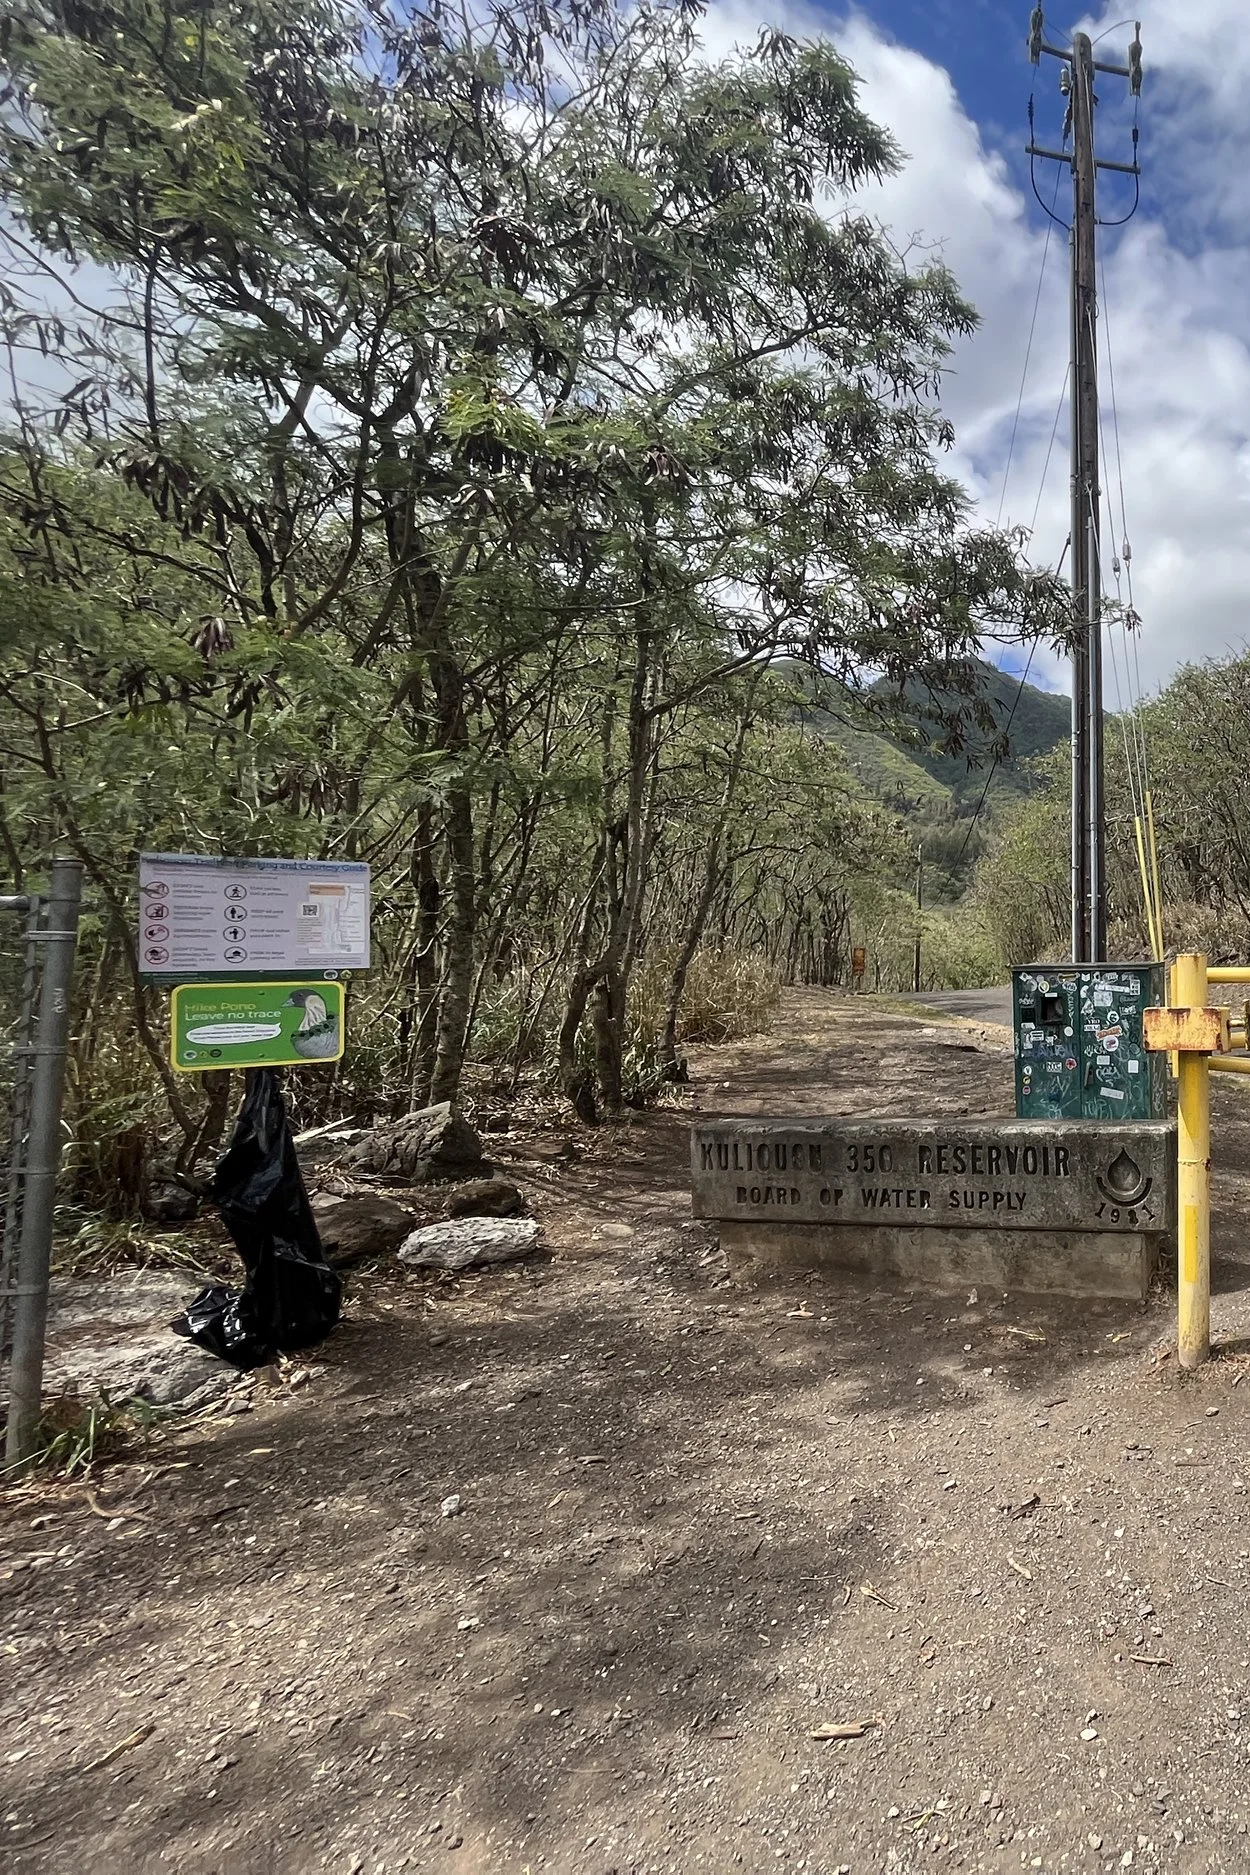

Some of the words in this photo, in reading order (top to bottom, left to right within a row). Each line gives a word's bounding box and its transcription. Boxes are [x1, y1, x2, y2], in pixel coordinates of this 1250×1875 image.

[278, 862, 297, 870] and
[299, 861, 341, 873] Courtesy
[342, 864, 368, 873] Guide
[184, 1004, 217, 1012] Hike
[220, 1002, 257, 1011] Pono
[185, 1012, 224, 1021] Leave
[248, 1010, 282, 1018] trace
[846, 1144, 894, 1174] 350
[918, 1144, 1071, 1177] RESERVOIR
[736, 1186, 801, 1206] BOARD
[861, 1188, 932, 1209] WATER
[948, 1190, 1027, 1211] SUPPLY
